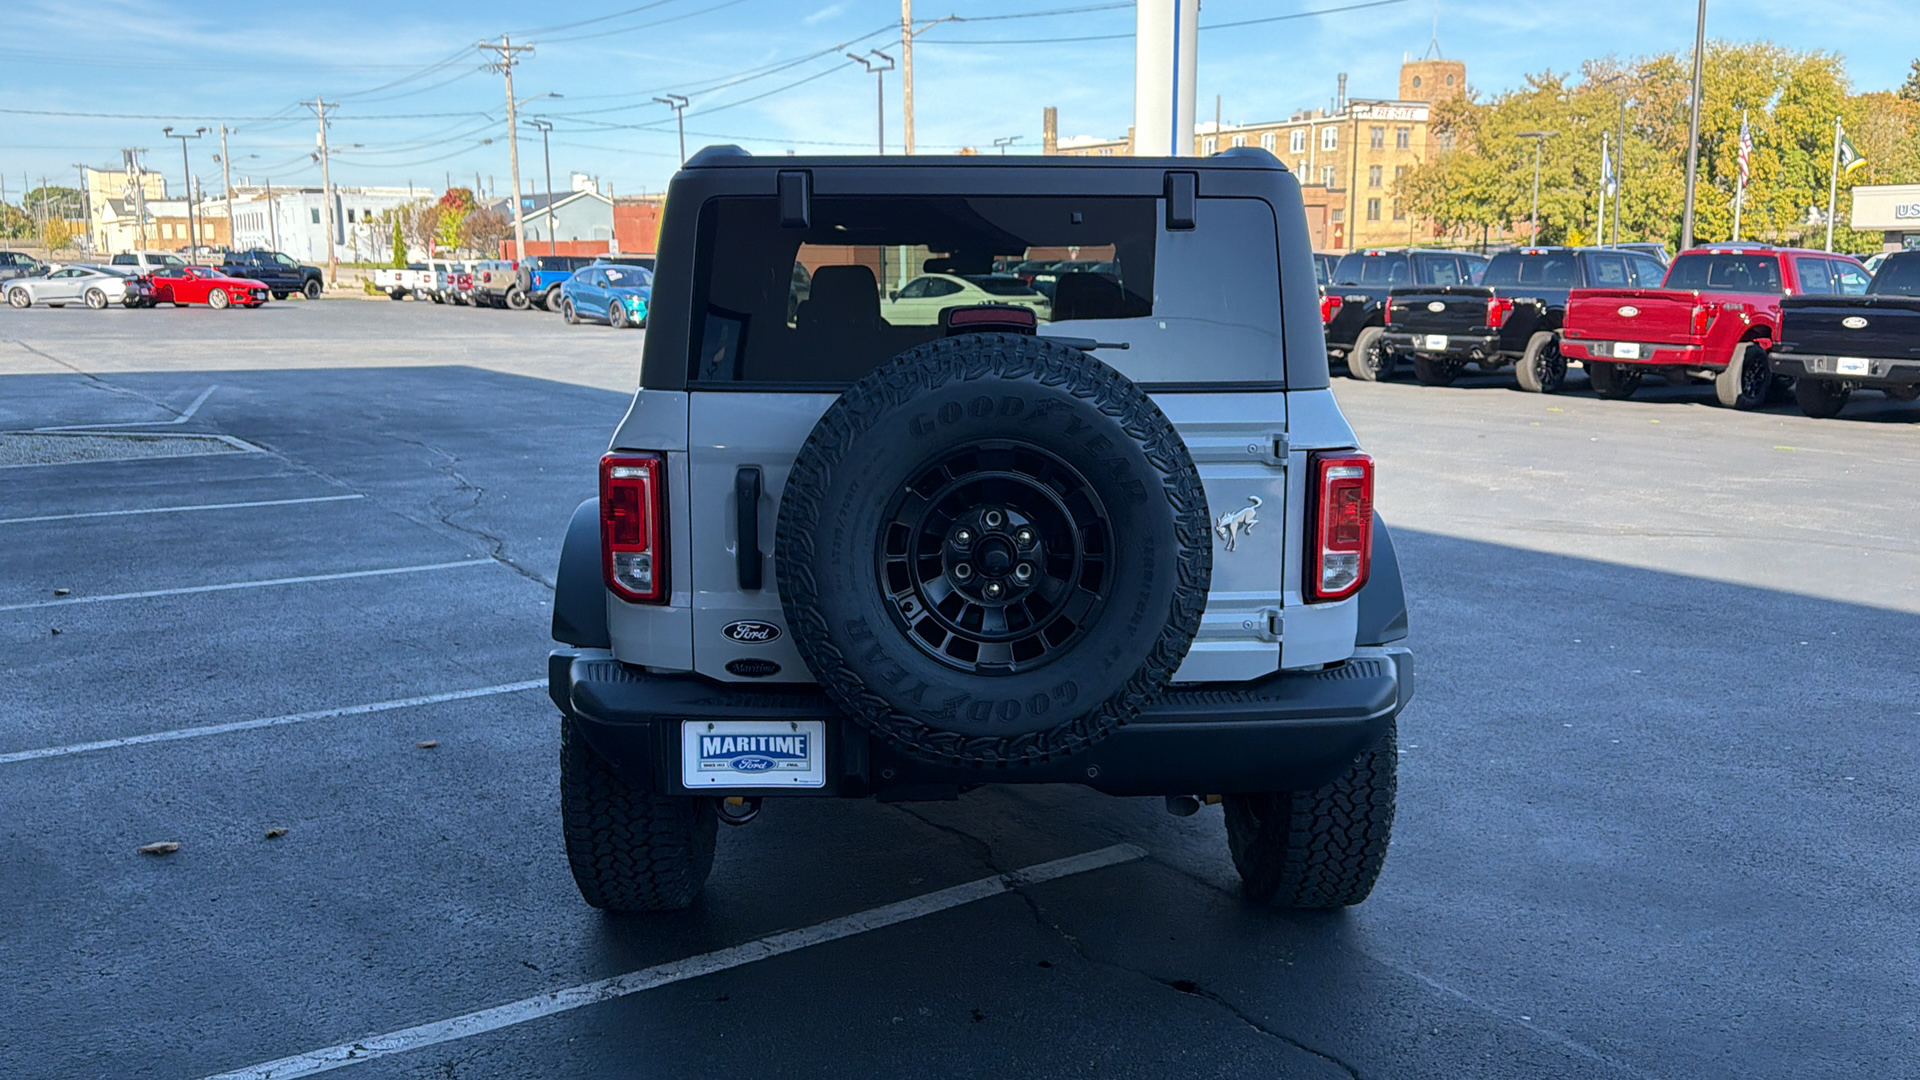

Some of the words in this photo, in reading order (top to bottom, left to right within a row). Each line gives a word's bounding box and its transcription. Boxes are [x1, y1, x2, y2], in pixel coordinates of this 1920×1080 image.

[733, 624, 769, 639] Ford
[732, 663, 776, 673] Maritime
[703, 736, 806, 757] MARITIME
[738, 758, 767, 770] Ford
